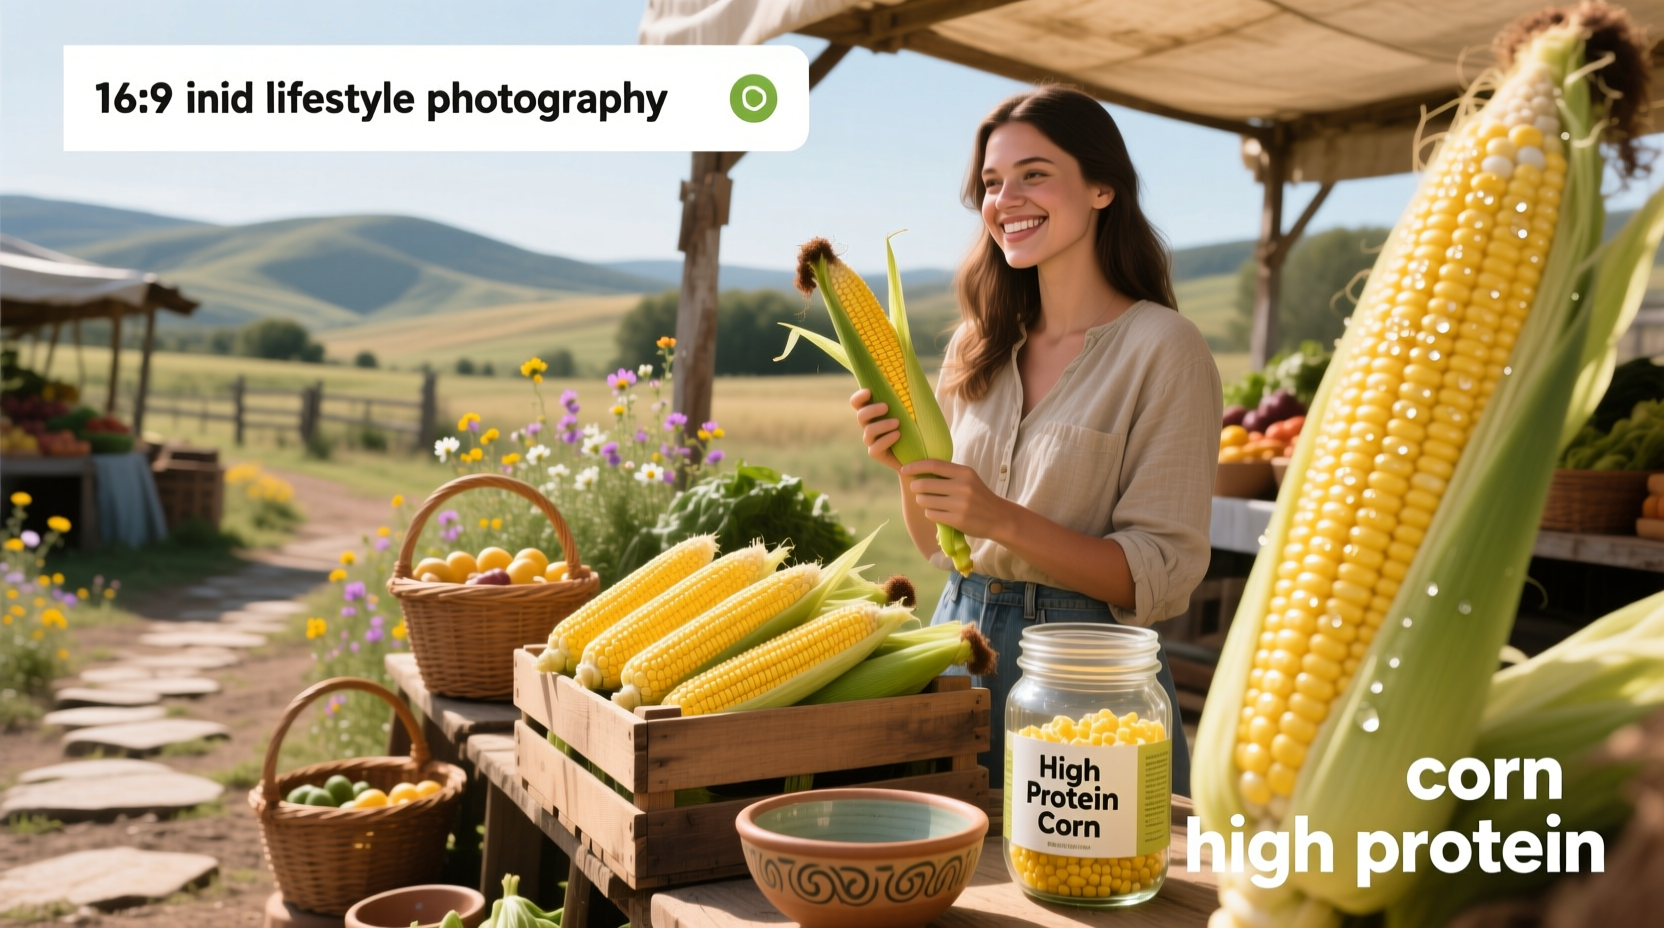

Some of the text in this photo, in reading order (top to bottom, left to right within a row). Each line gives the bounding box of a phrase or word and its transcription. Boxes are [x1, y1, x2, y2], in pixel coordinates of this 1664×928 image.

[1040, 754, 1101, 789] High
[1027, 780, 1120, 811] Protein
[1038, 810, 1101, 838] Corn
